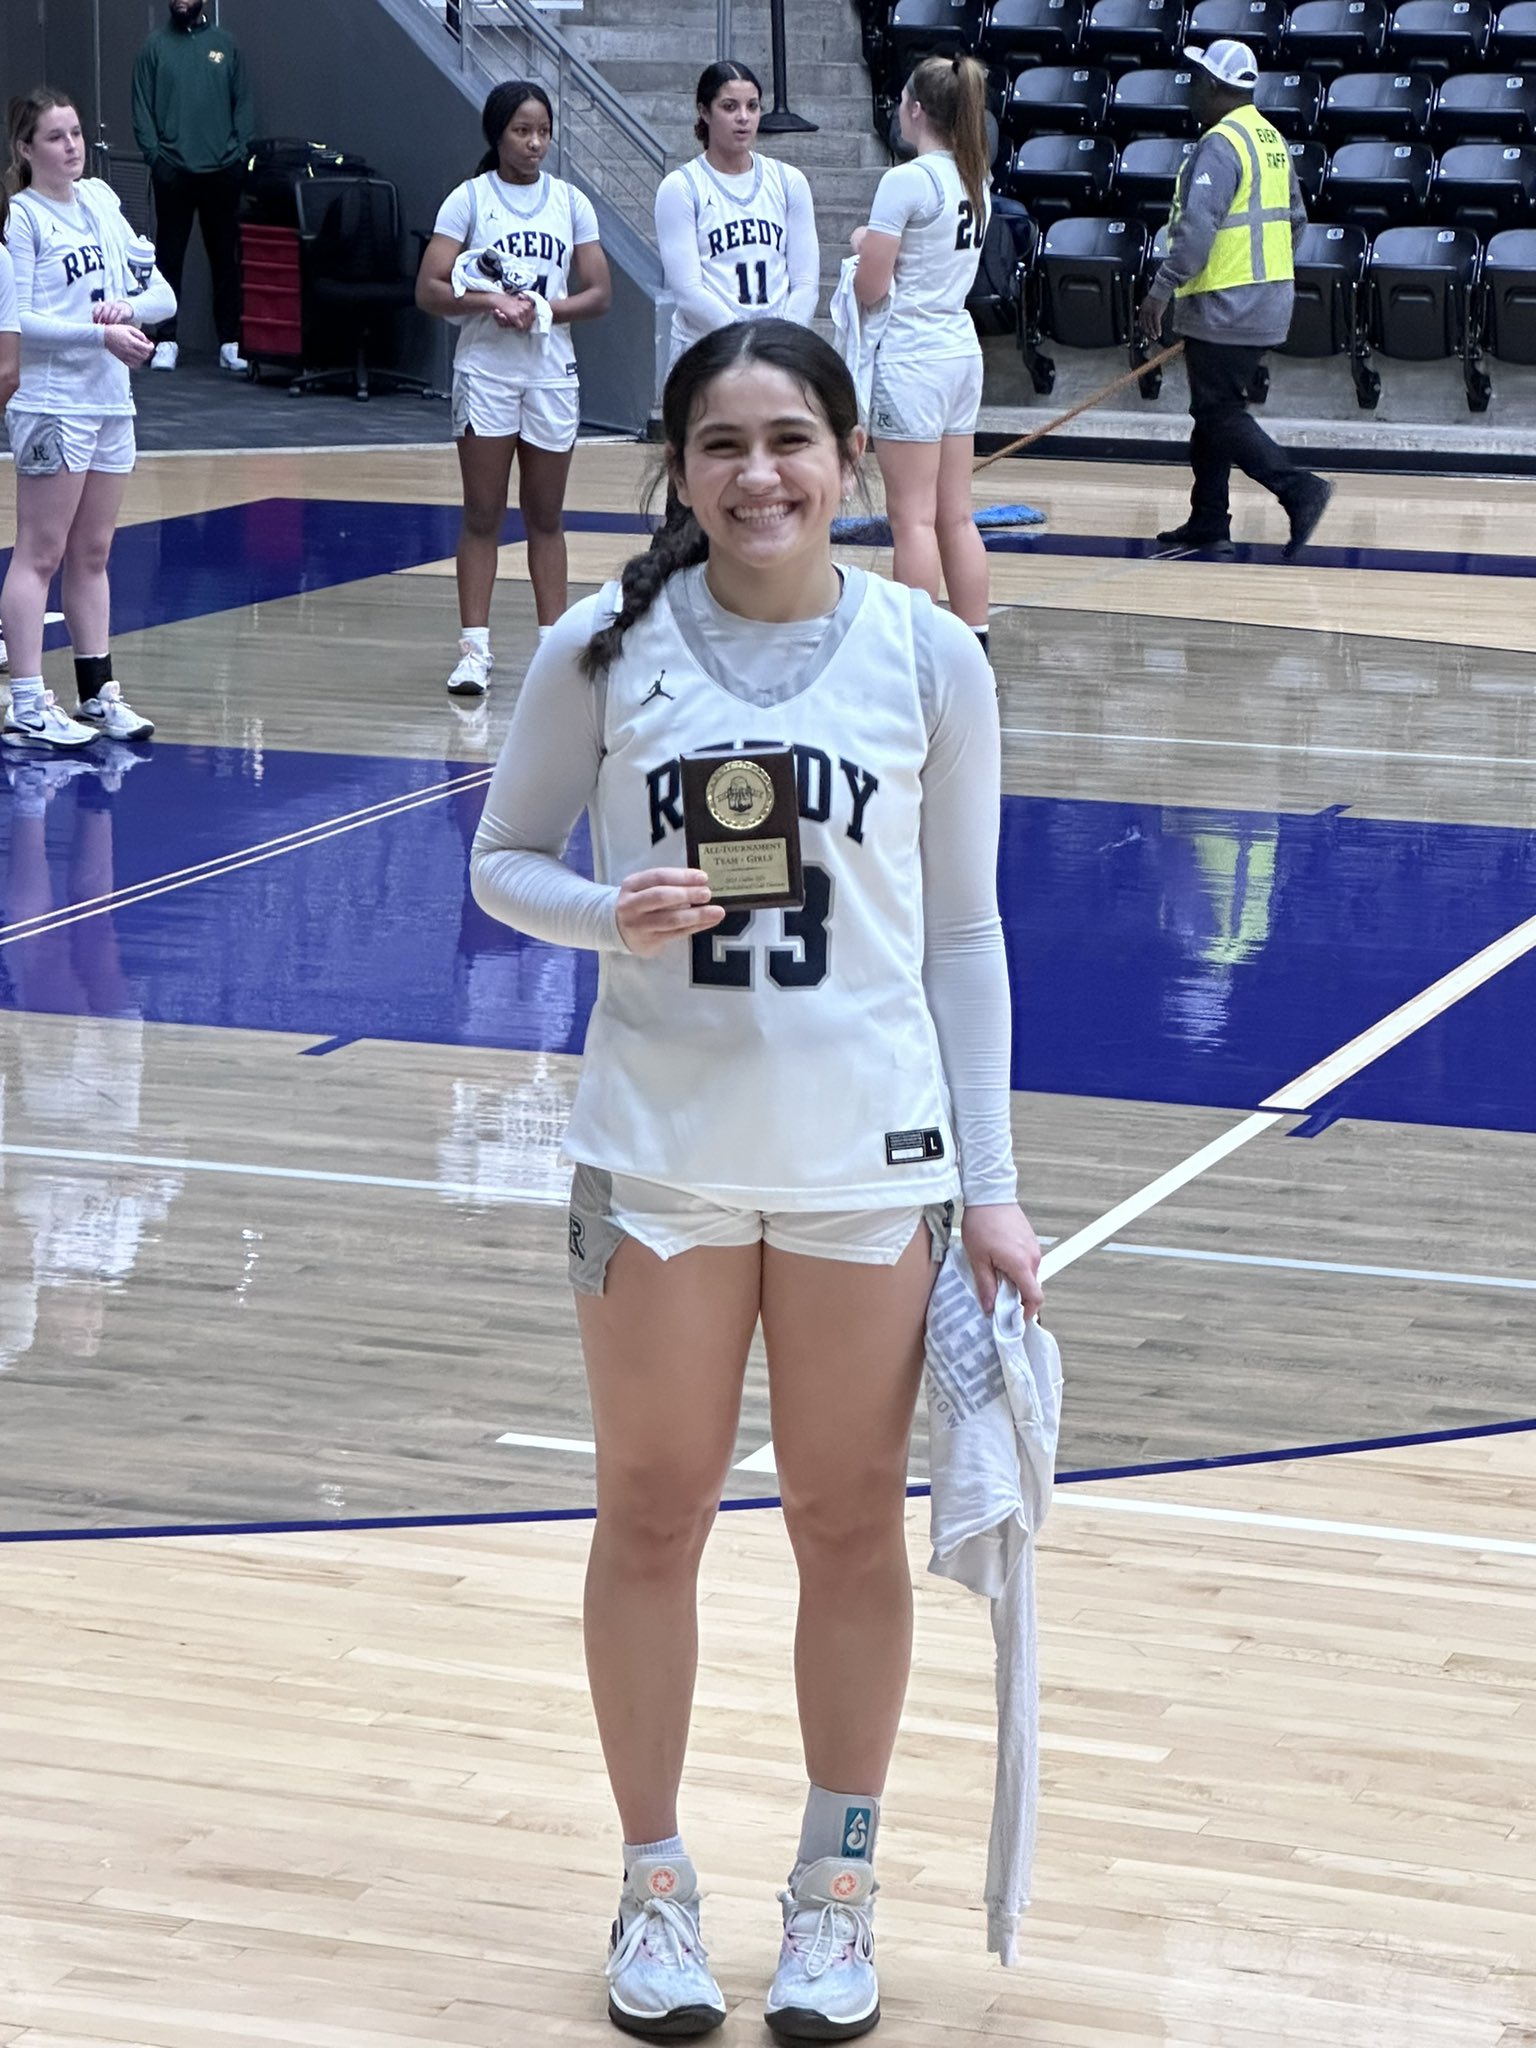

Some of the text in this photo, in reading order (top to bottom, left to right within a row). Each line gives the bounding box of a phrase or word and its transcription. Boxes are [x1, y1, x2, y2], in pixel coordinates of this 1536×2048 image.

[708, 218, 783, 259] REEDY
[62, 245, 105, 287] REE
[735, 261, 767, 305] 11
[530, 275, 548, 301] 4
[645, 739, 879, 848] RDY
[713, 857, 738, 866] TEAM
[746, 854, 773, 864] GIRLS
[688, 860, 835, 992] 23
[930, 1137, 938, 1150] L
